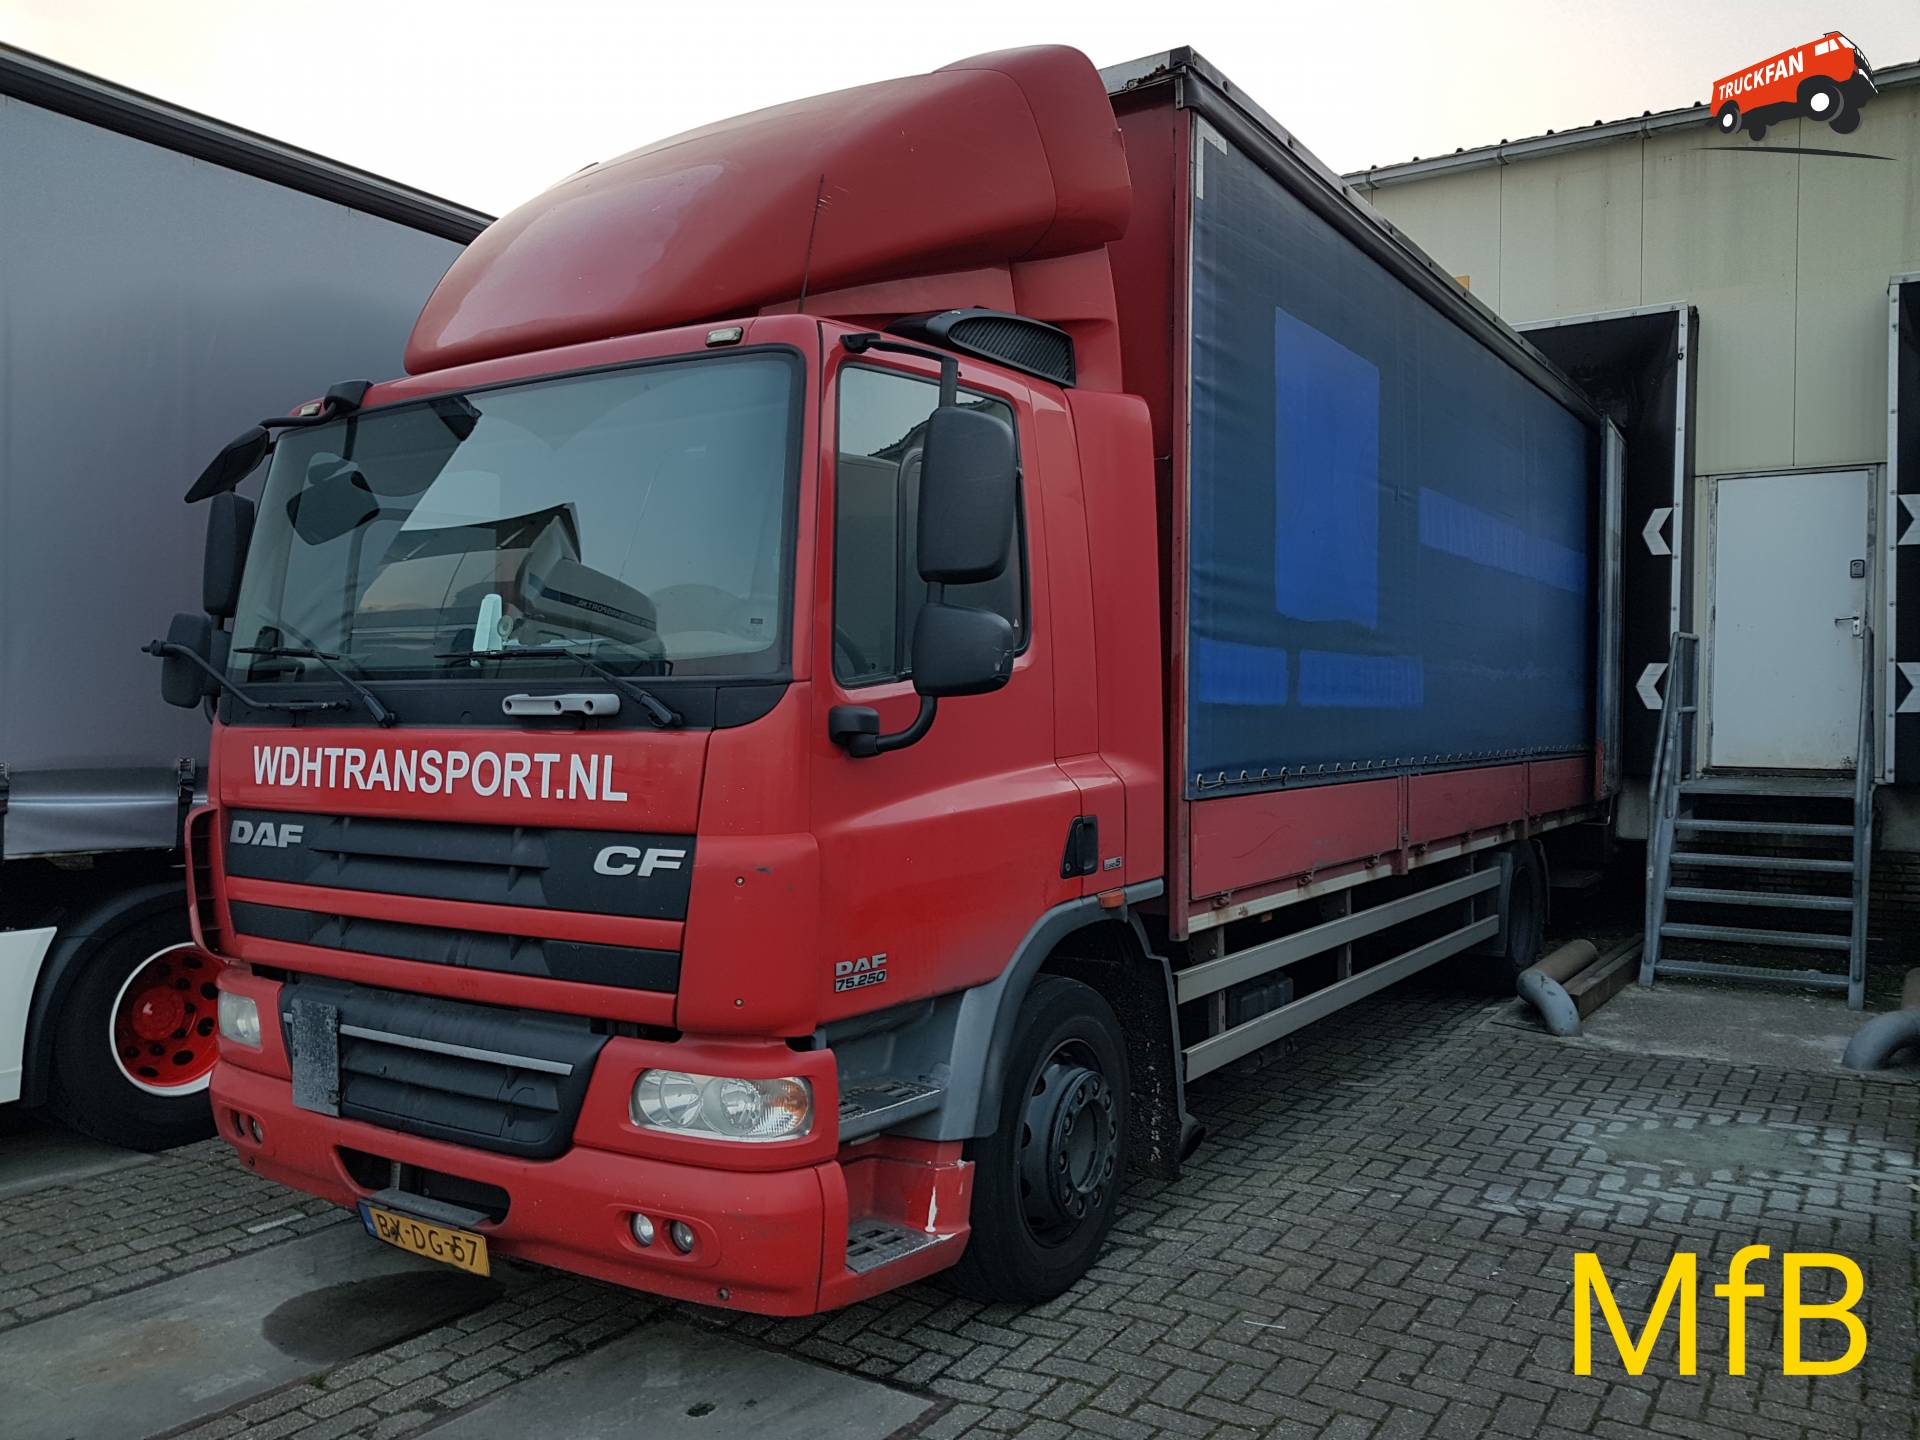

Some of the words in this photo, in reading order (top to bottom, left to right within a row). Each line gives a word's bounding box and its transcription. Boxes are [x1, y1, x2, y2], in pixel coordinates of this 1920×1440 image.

[253, 745, 628, 802] WDHTRANSPORT.NL
[230, 820, 304, 848] DAF
[593, 845, 687, 877] CF
[835, 953, 887, 977] DAF
[836, 970, 886, 991] 75.250
